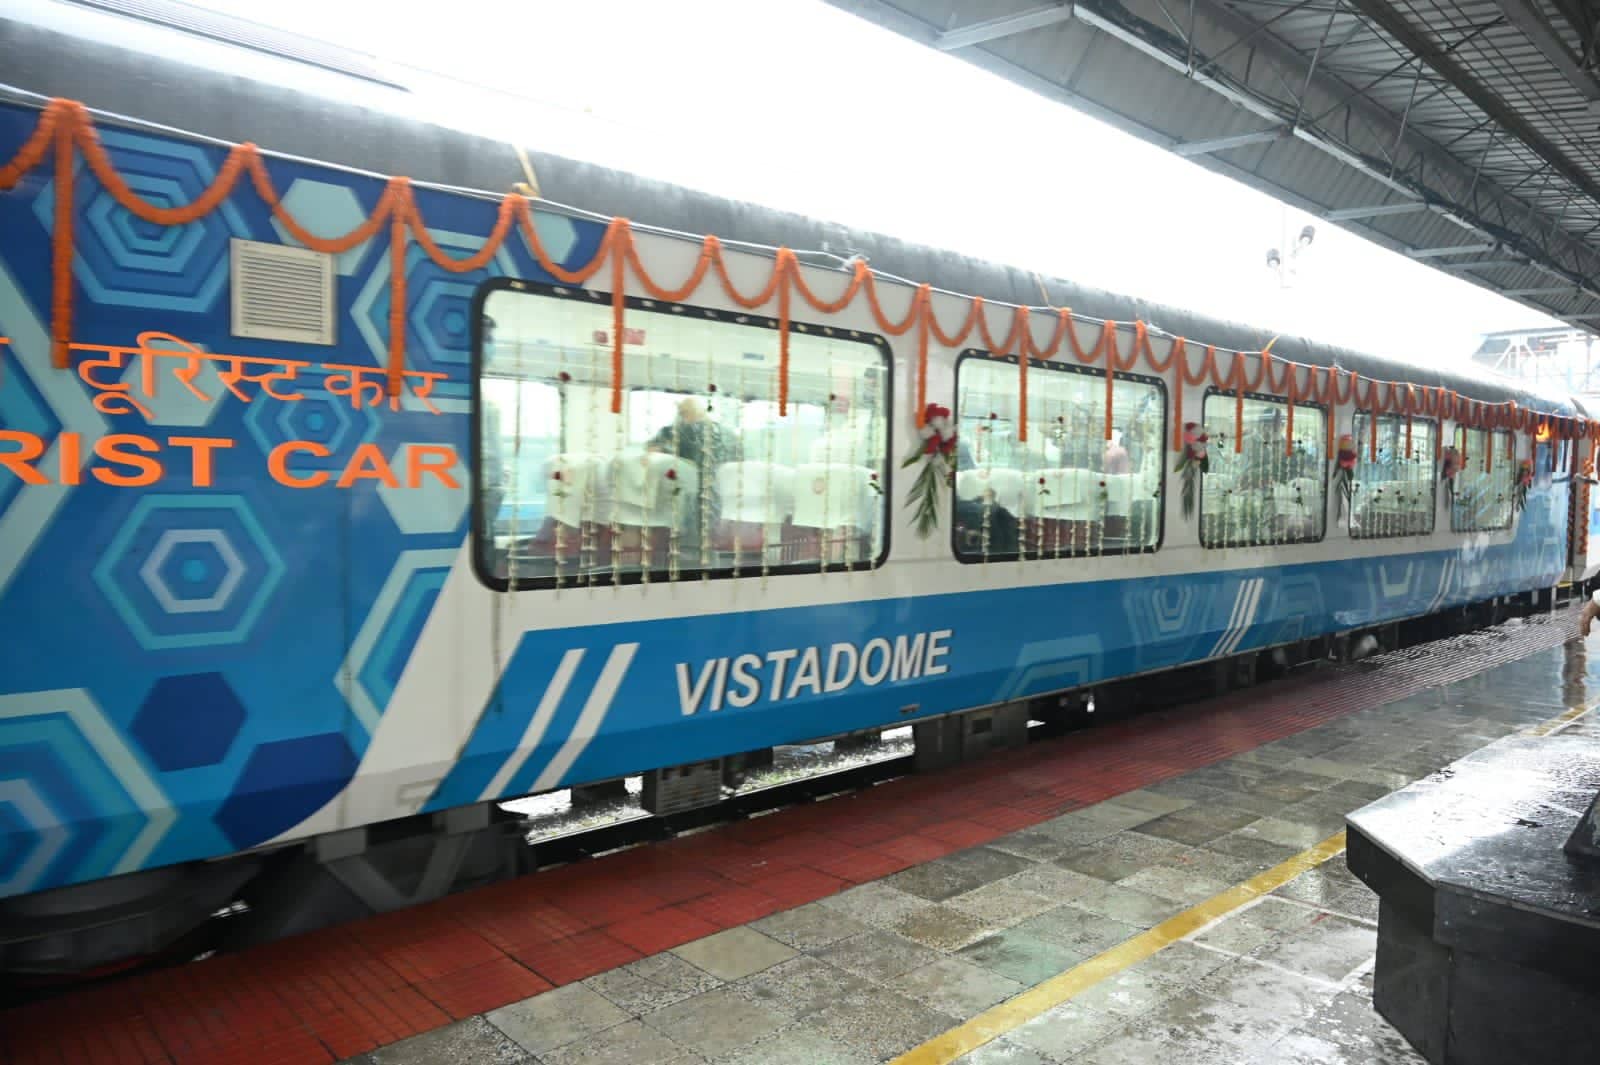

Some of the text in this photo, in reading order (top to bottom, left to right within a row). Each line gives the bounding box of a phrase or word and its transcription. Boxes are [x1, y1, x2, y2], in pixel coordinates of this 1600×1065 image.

[70, 331, 311, 420] टूरिस्ट
[0, 429, 462, 490] RIST CAR
[675, 629, 952, 716] VISTADOME
